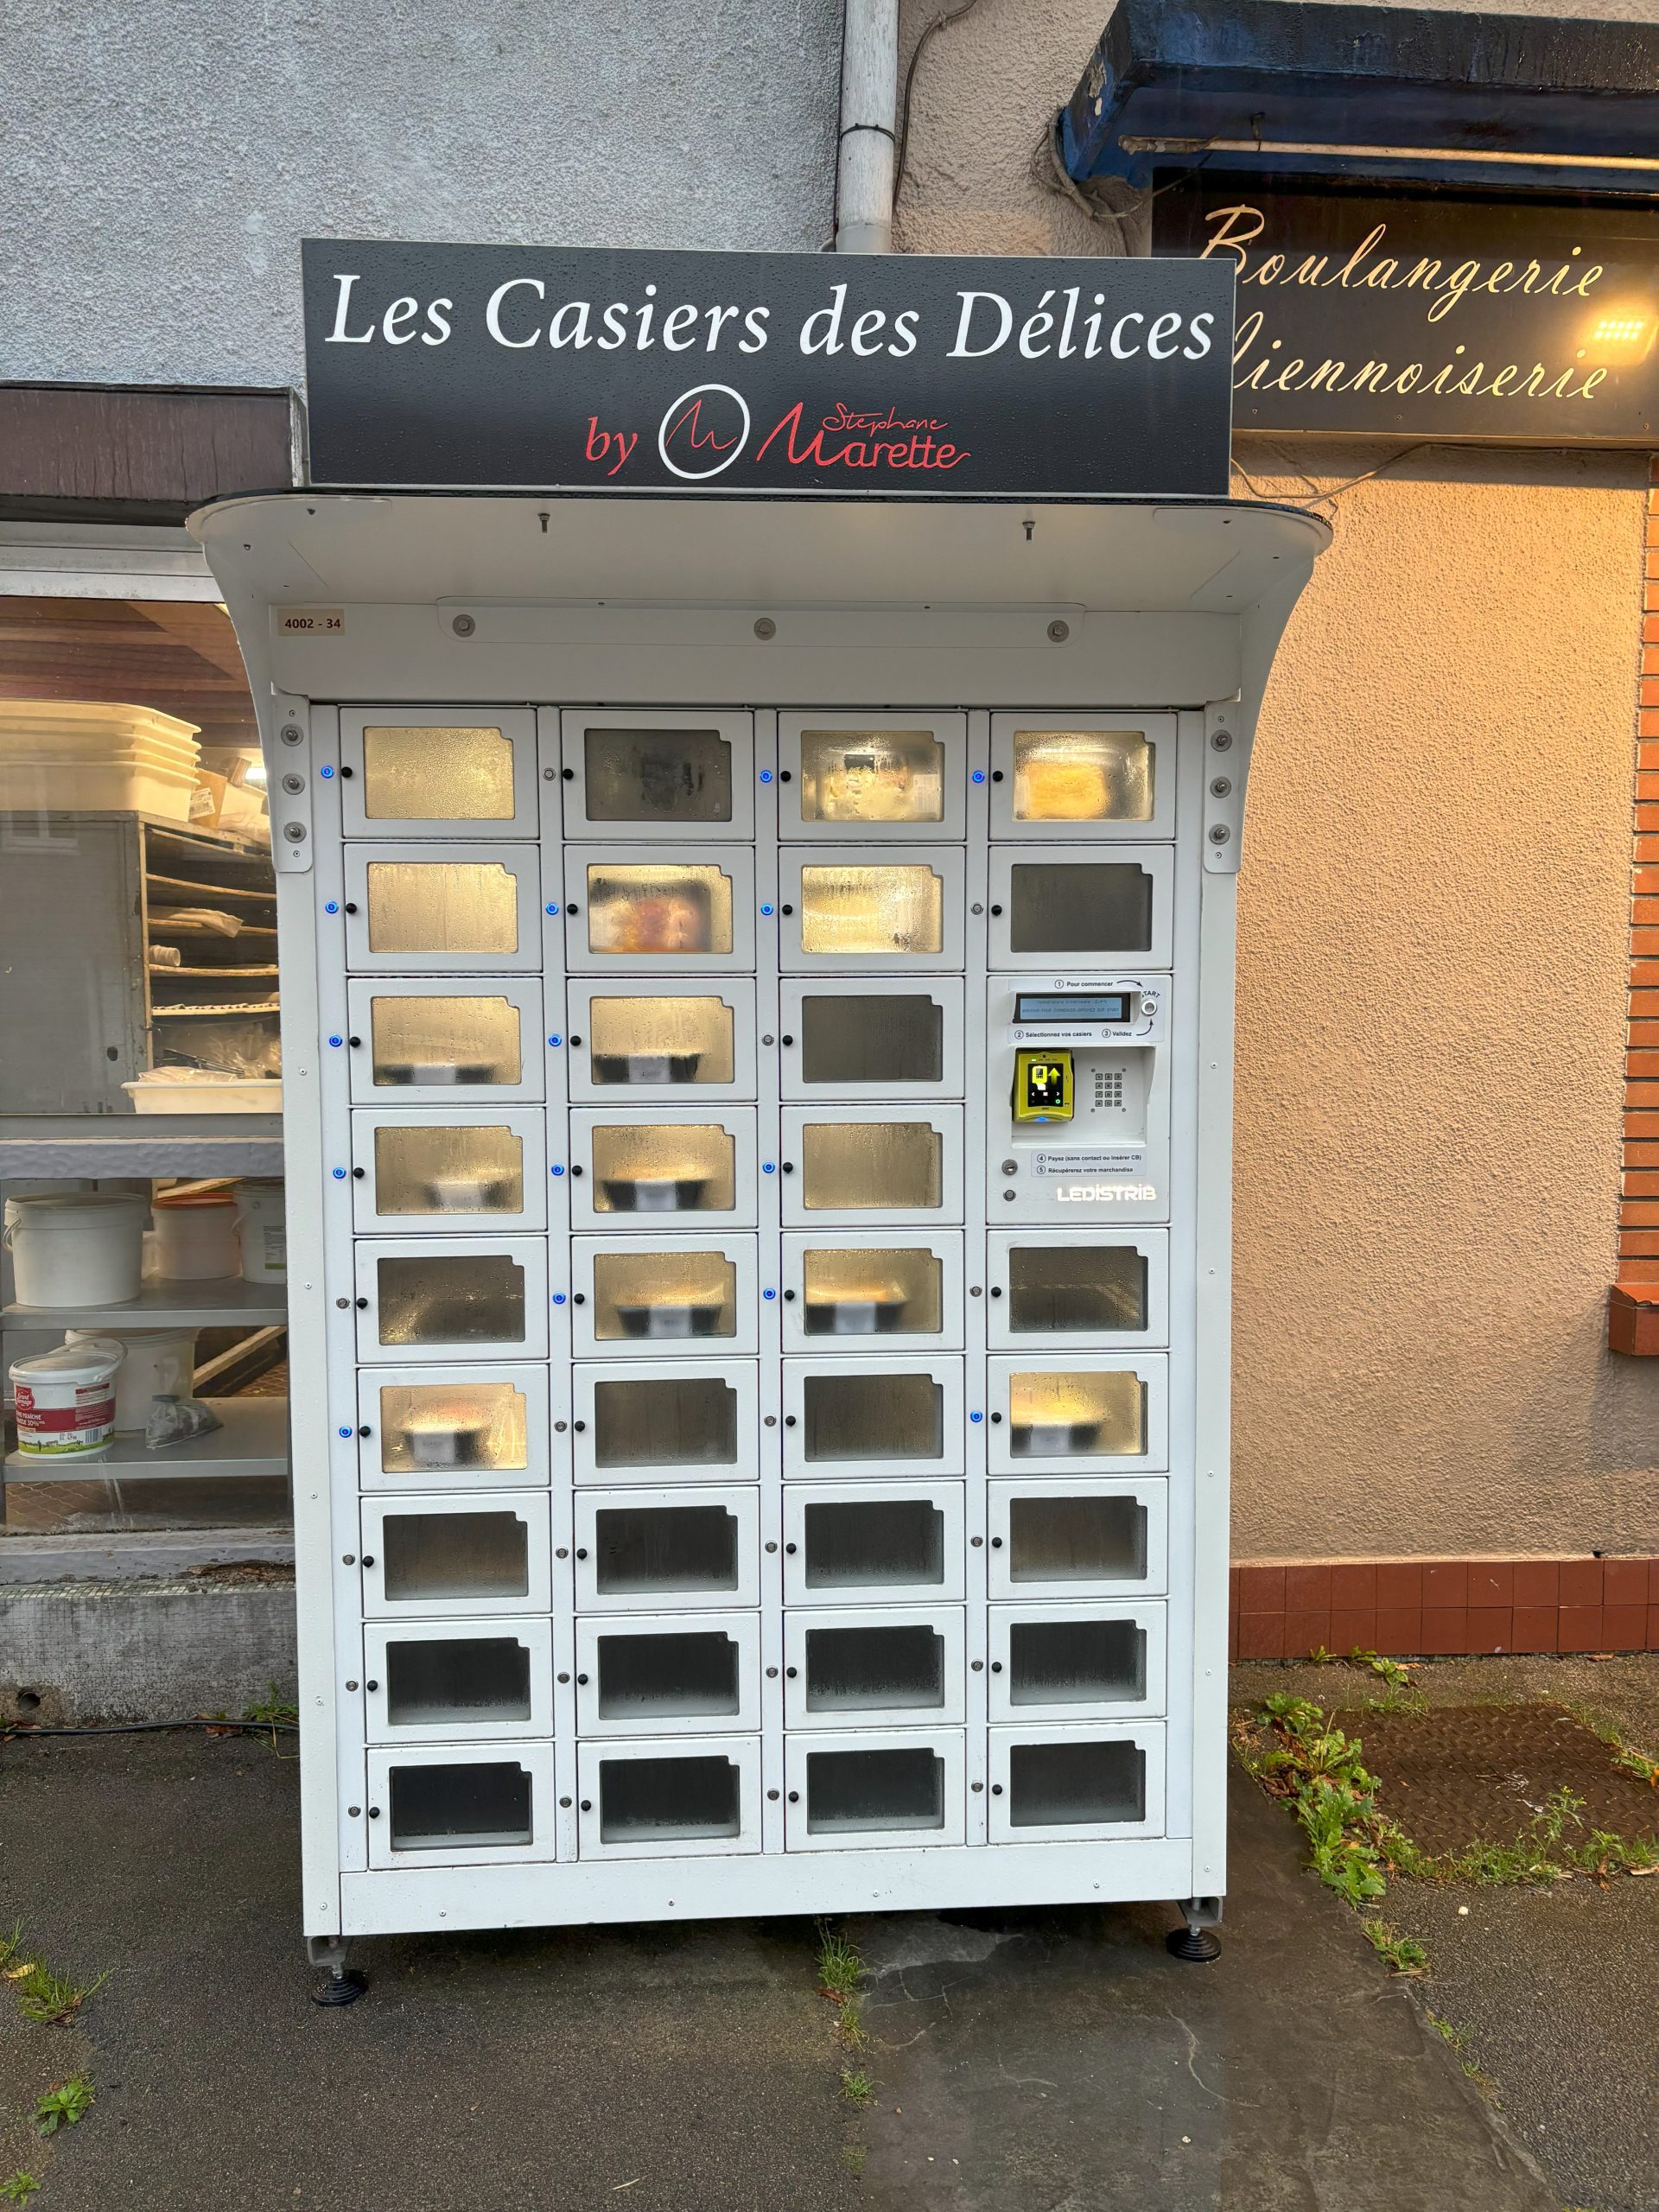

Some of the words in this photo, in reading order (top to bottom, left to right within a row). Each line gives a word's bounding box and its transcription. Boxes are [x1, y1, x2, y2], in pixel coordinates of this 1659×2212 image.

[1200, 204, 1603, 322] Boulangerie
[324, 274, 454, 346] Les
[486, 278, 771, 353] Casiers
[799, 283, 920, 358] des
[945, 286, 1215, 360] Délices
[585, 416, 639, 476] by
[756, 402, 971, 470] Marette
[284, 619, 314, 629] 4002
[326, 619, 341, 629] 34
